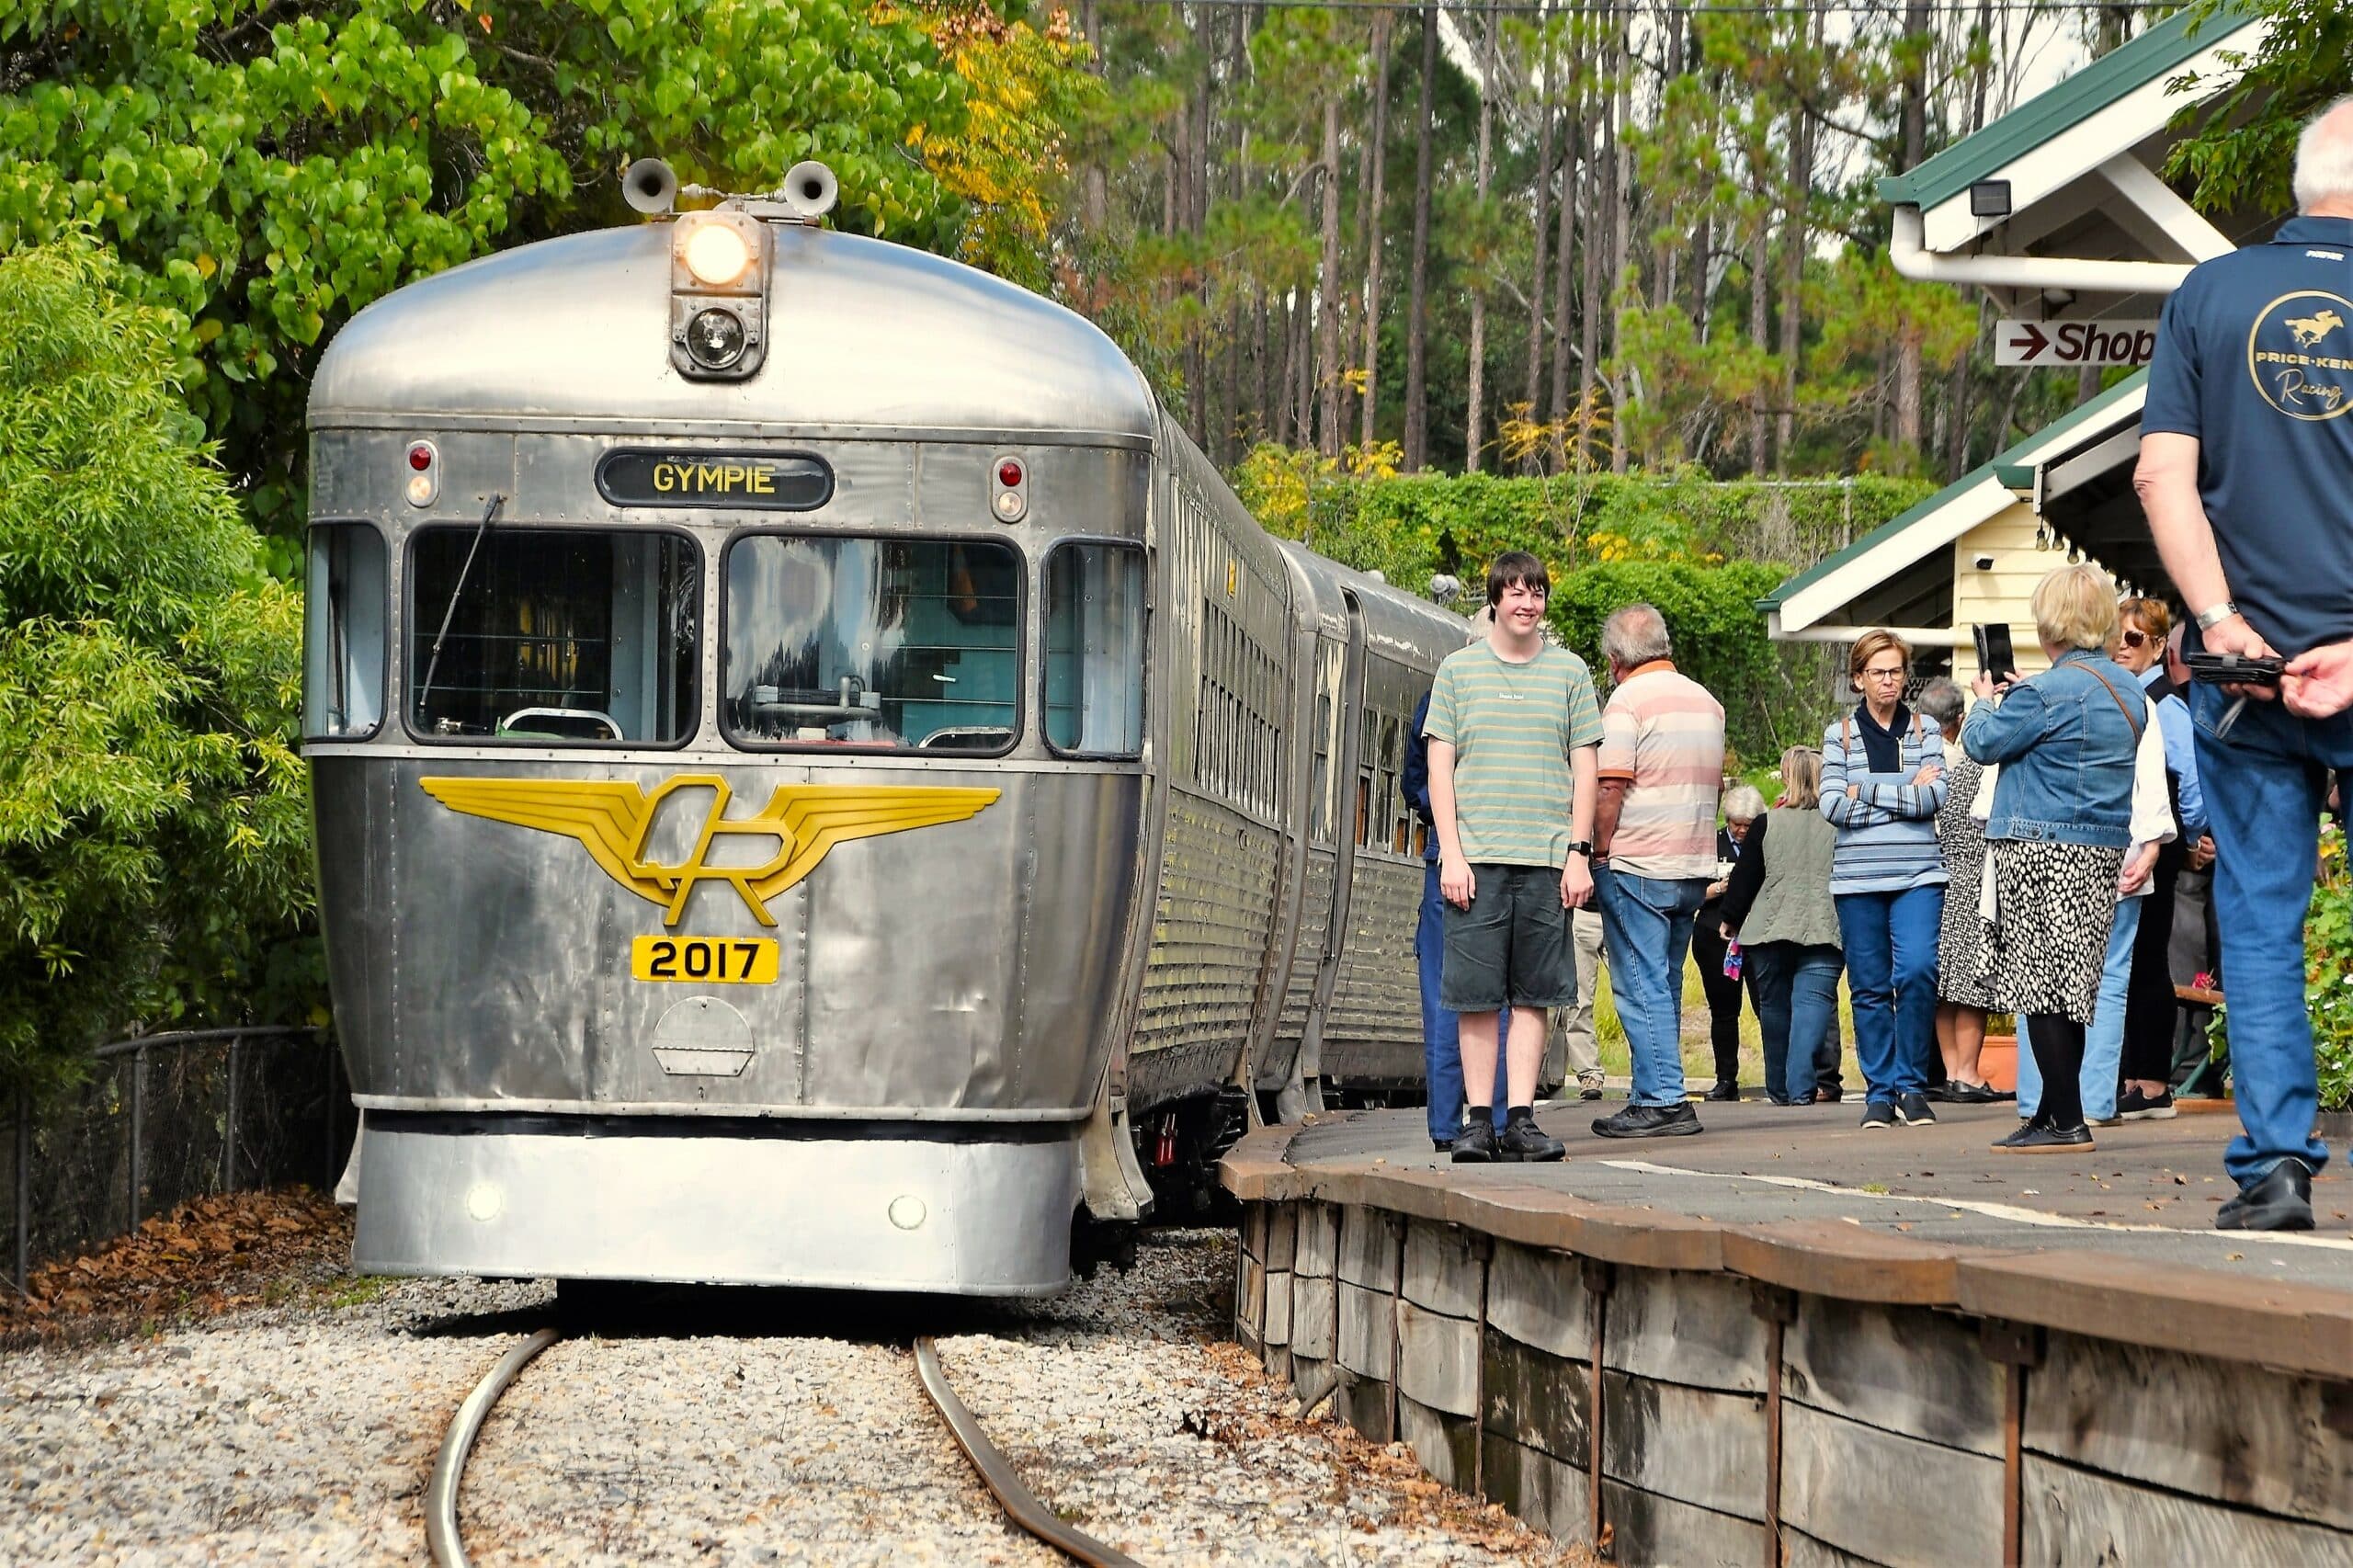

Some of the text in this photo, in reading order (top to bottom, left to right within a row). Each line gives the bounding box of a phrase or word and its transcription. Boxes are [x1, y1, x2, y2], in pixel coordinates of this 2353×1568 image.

[2054, 324, 2156, 365] Shop
[2275, 369, 2343, 410] Racing
[654, 463, 776, 494] GYMPIE
[651, 941, 761, 979] 2017
